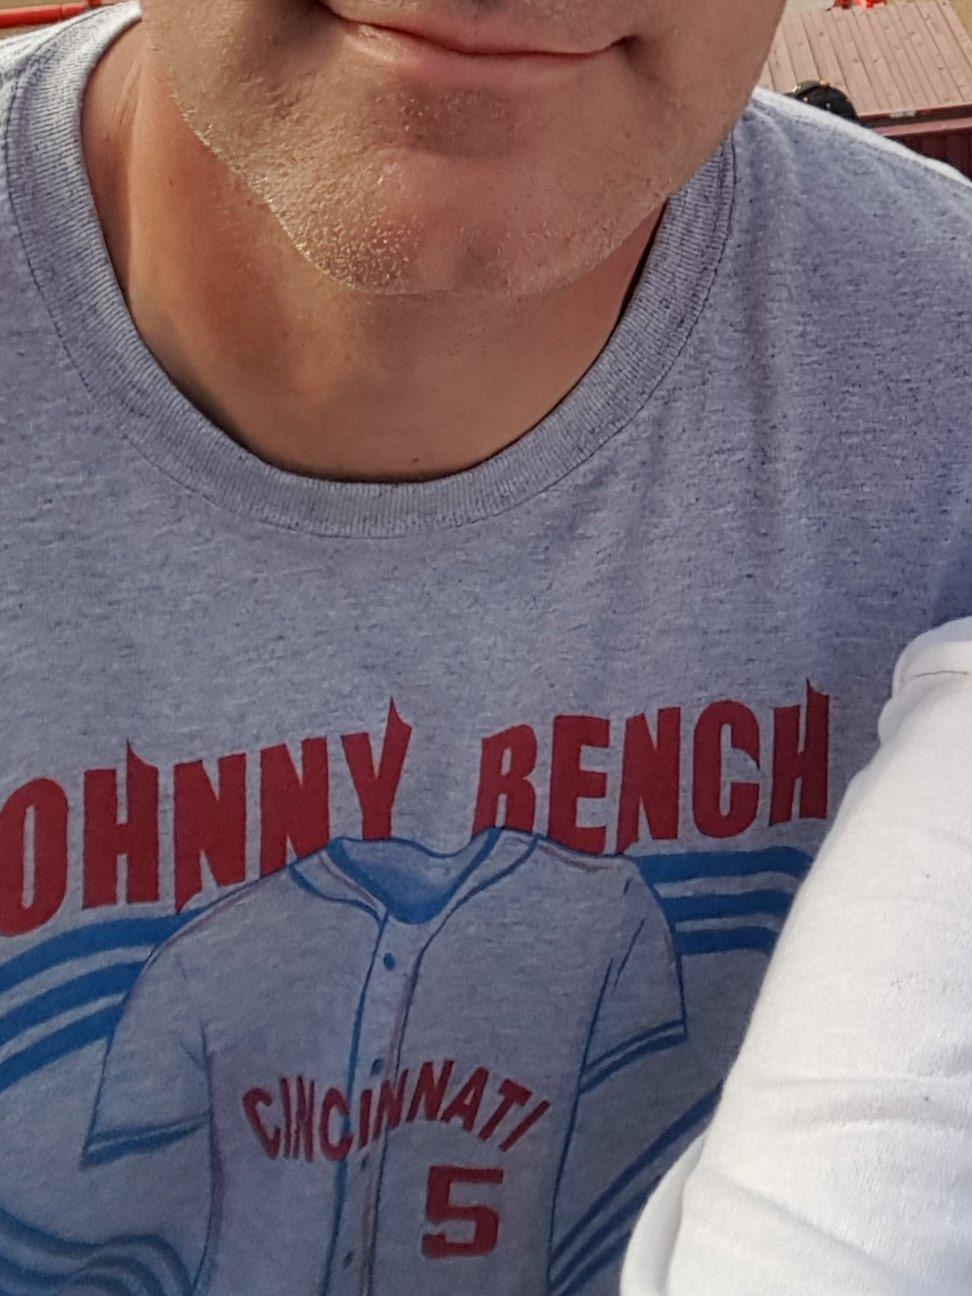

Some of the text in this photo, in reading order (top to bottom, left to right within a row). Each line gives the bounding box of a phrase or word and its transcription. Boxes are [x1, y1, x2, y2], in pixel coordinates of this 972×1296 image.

[0, 679, 831, 938] OHNNY BENCH
[242, 1060, 551, 1163] CINCINNATI
[422, 1166, 504, 1259] 5
